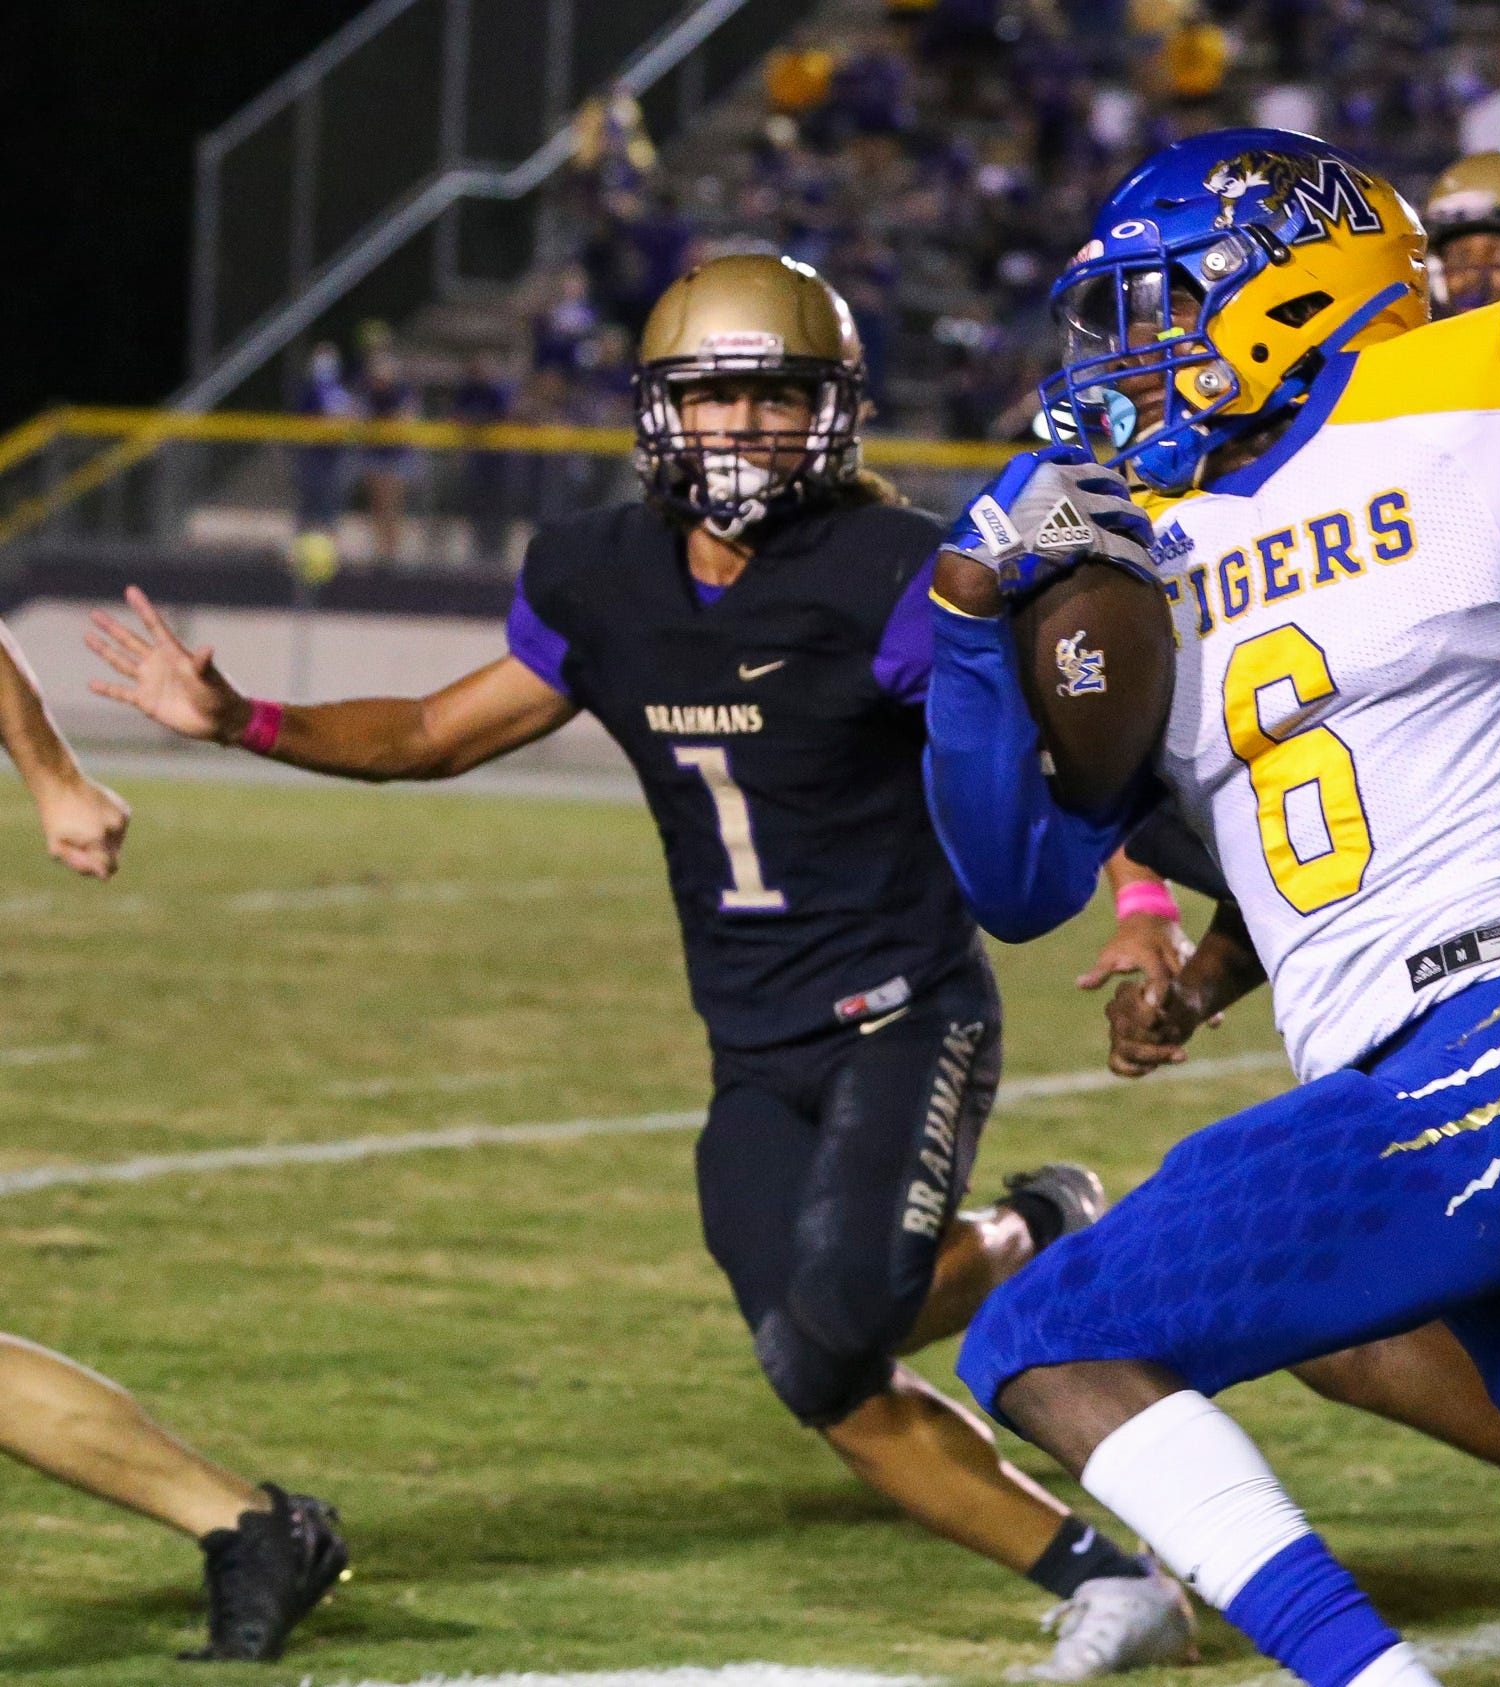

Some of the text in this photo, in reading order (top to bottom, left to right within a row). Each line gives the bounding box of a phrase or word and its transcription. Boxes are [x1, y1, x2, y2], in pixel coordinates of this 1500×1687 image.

[1284, 159, 1384, 247] M
[1070, 649, 1108, 697] M
[644, 703, 764, 735] BRAHMANS
[1222, 621, 1377, 917] 6
[671, 744, 789, 912] 1
